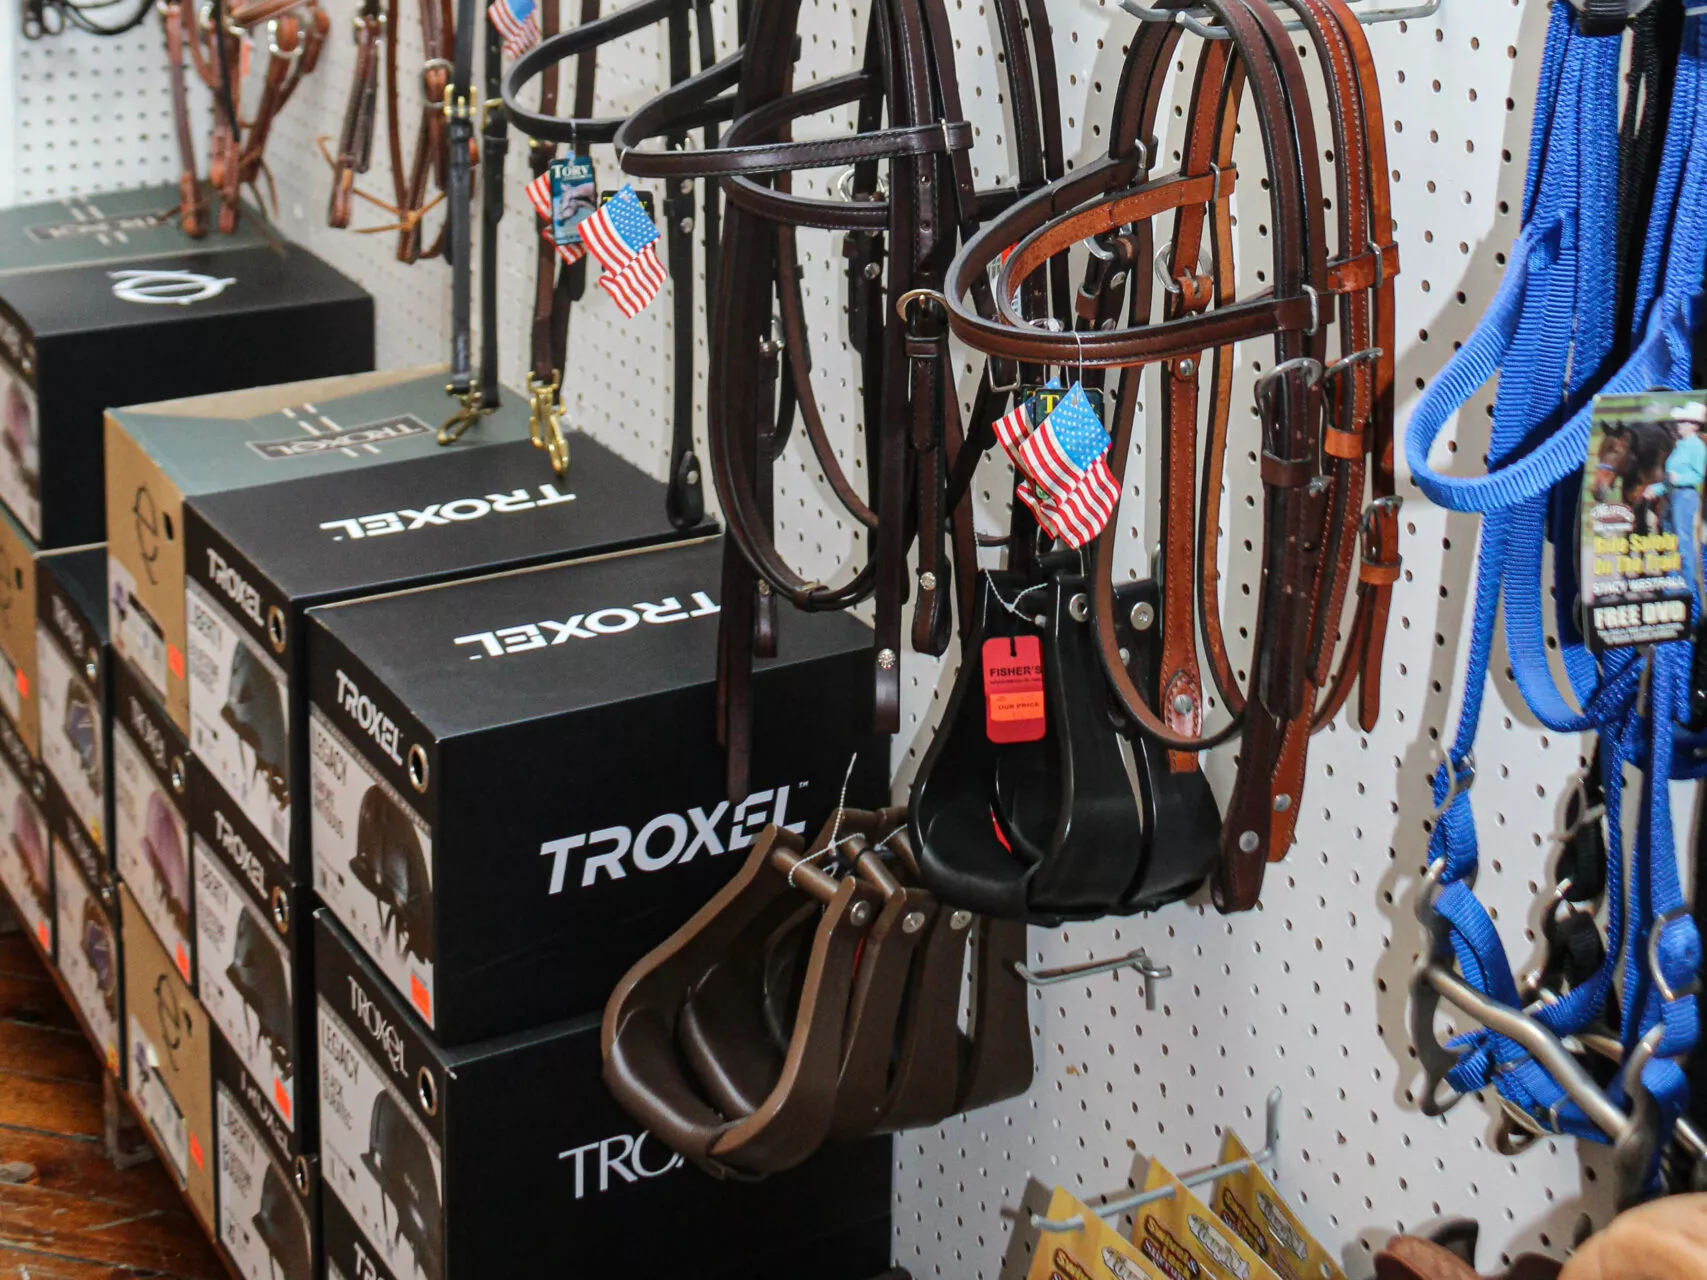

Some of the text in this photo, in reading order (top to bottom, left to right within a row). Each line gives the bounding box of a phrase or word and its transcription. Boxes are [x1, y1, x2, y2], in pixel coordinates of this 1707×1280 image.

[320, 484, 576, 538] TROXEL
[207, 548, 264, 626] TROXEL
[1593, 604, 1641, 629] FREE
[454, 592, 720, 656] TROXEL
[990, 666, 1043, 677] FISHER'S
[336, 670, 402, 765] TROXEL
[214, 811, 268, 899] TROXEL
[540, 785, 805, 894] TROXEL
